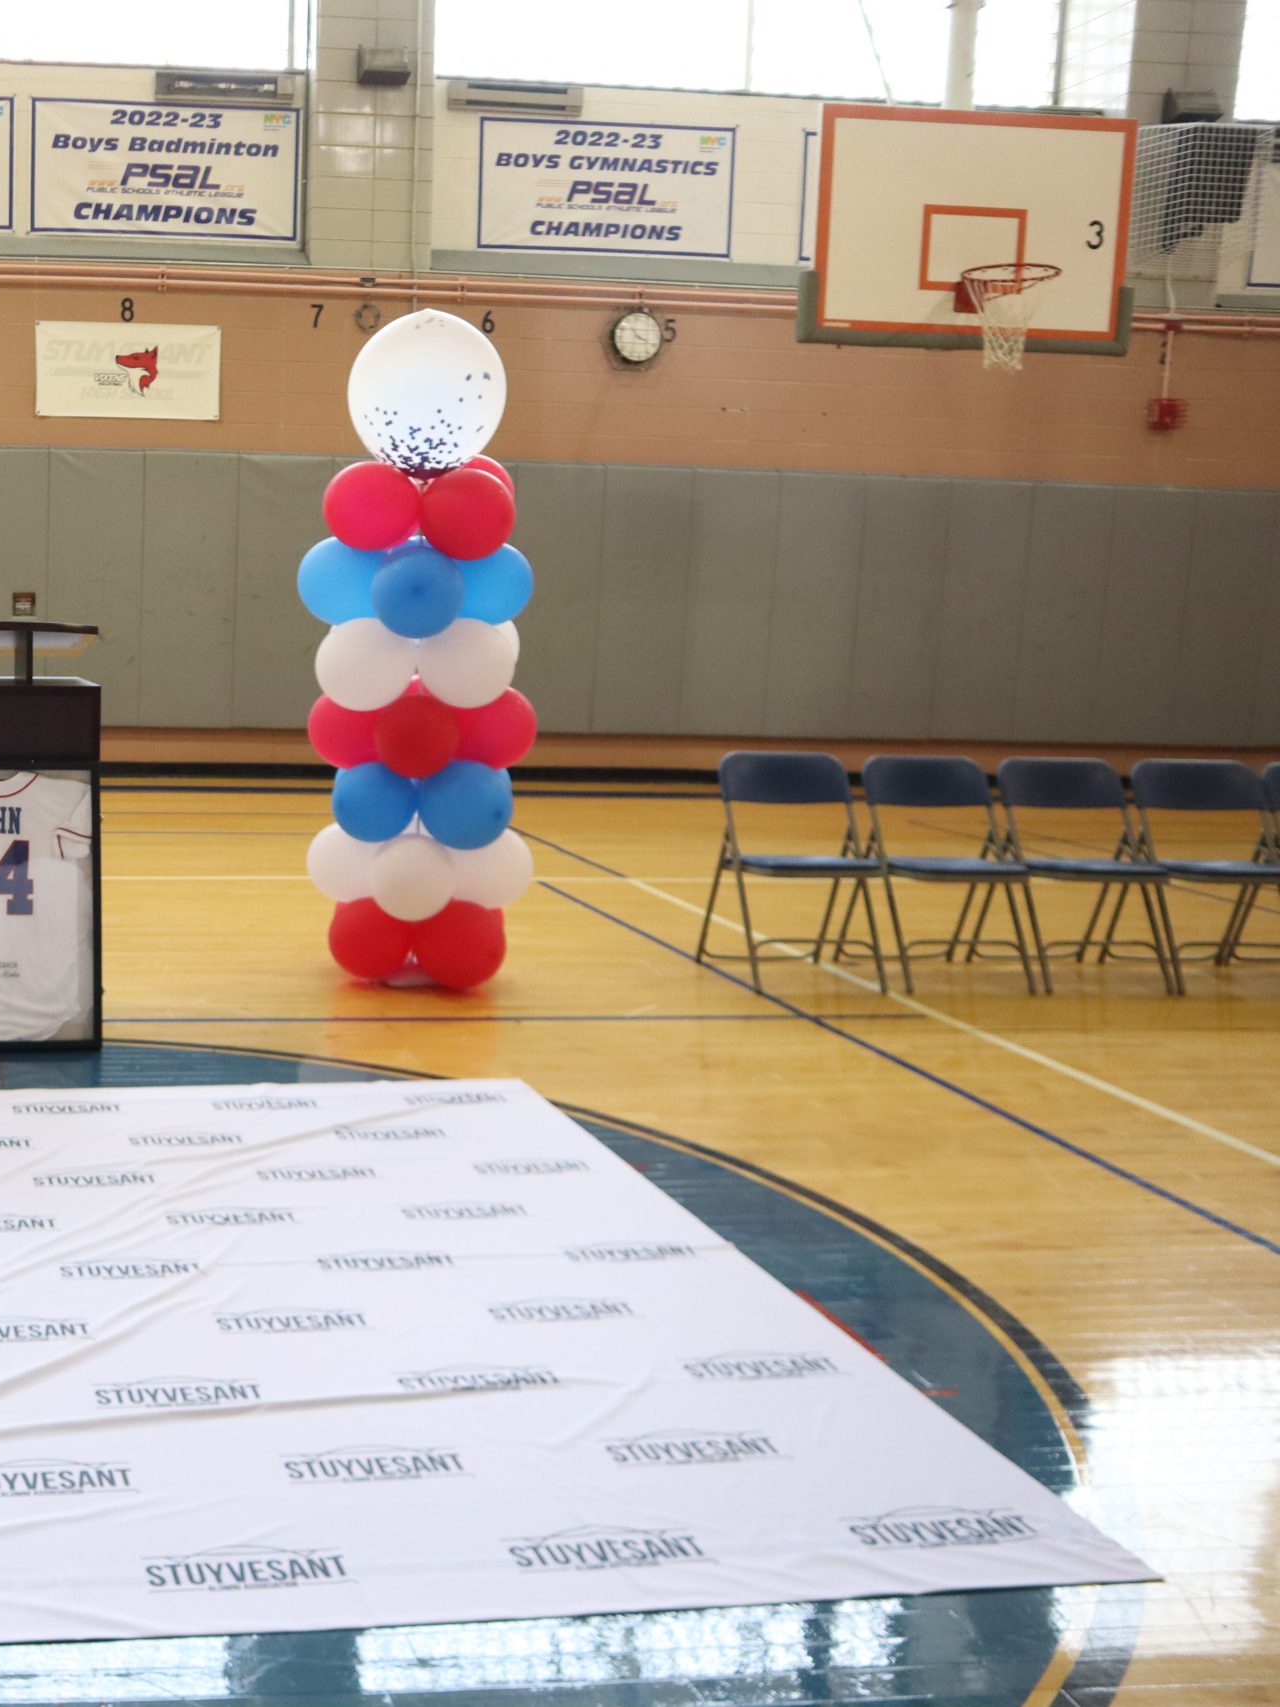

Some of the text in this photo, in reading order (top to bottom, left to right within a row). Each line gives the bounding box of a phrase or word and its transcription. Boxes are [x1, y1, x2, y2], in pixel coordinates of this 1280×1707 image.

[110, 109, 223, 129] 2022-23
[52, 134, 279, 157] Boys Badminton
[554, 129, 663, 149] 2022-23
[495, 152, 719, 176] BOYS GYMNASTICS
[73, 202, 257, 226] CHAMPIONS
[530, 220, 682, 241] CHAMPIONS
[1086, 220, 1104, 250] 3
[121, 297, 135, 322] 8
[310, 304, 324, 328] 7
[481, 310, 496, 334] 6
[664, 319, 677, 342] 5
[33, 1174, 155, 1186] STUYVESANT
[60, 1262, 201, 1278] STUYVESANT
[218, 1313, 367, 1332] STUYVESANT
[95, 1383, 262, 1405] STUYVESANT
[606, 1436, 780, 1463] STUYVESANT
[284, 1453, 465, 1479] STUYVESANT
[849, 1514, 1039, 1546] STUYVESANT
[509, 1536, 706, 1568] STUYVESANT
[145, 1555, 348, 1587] STUYVESANT
